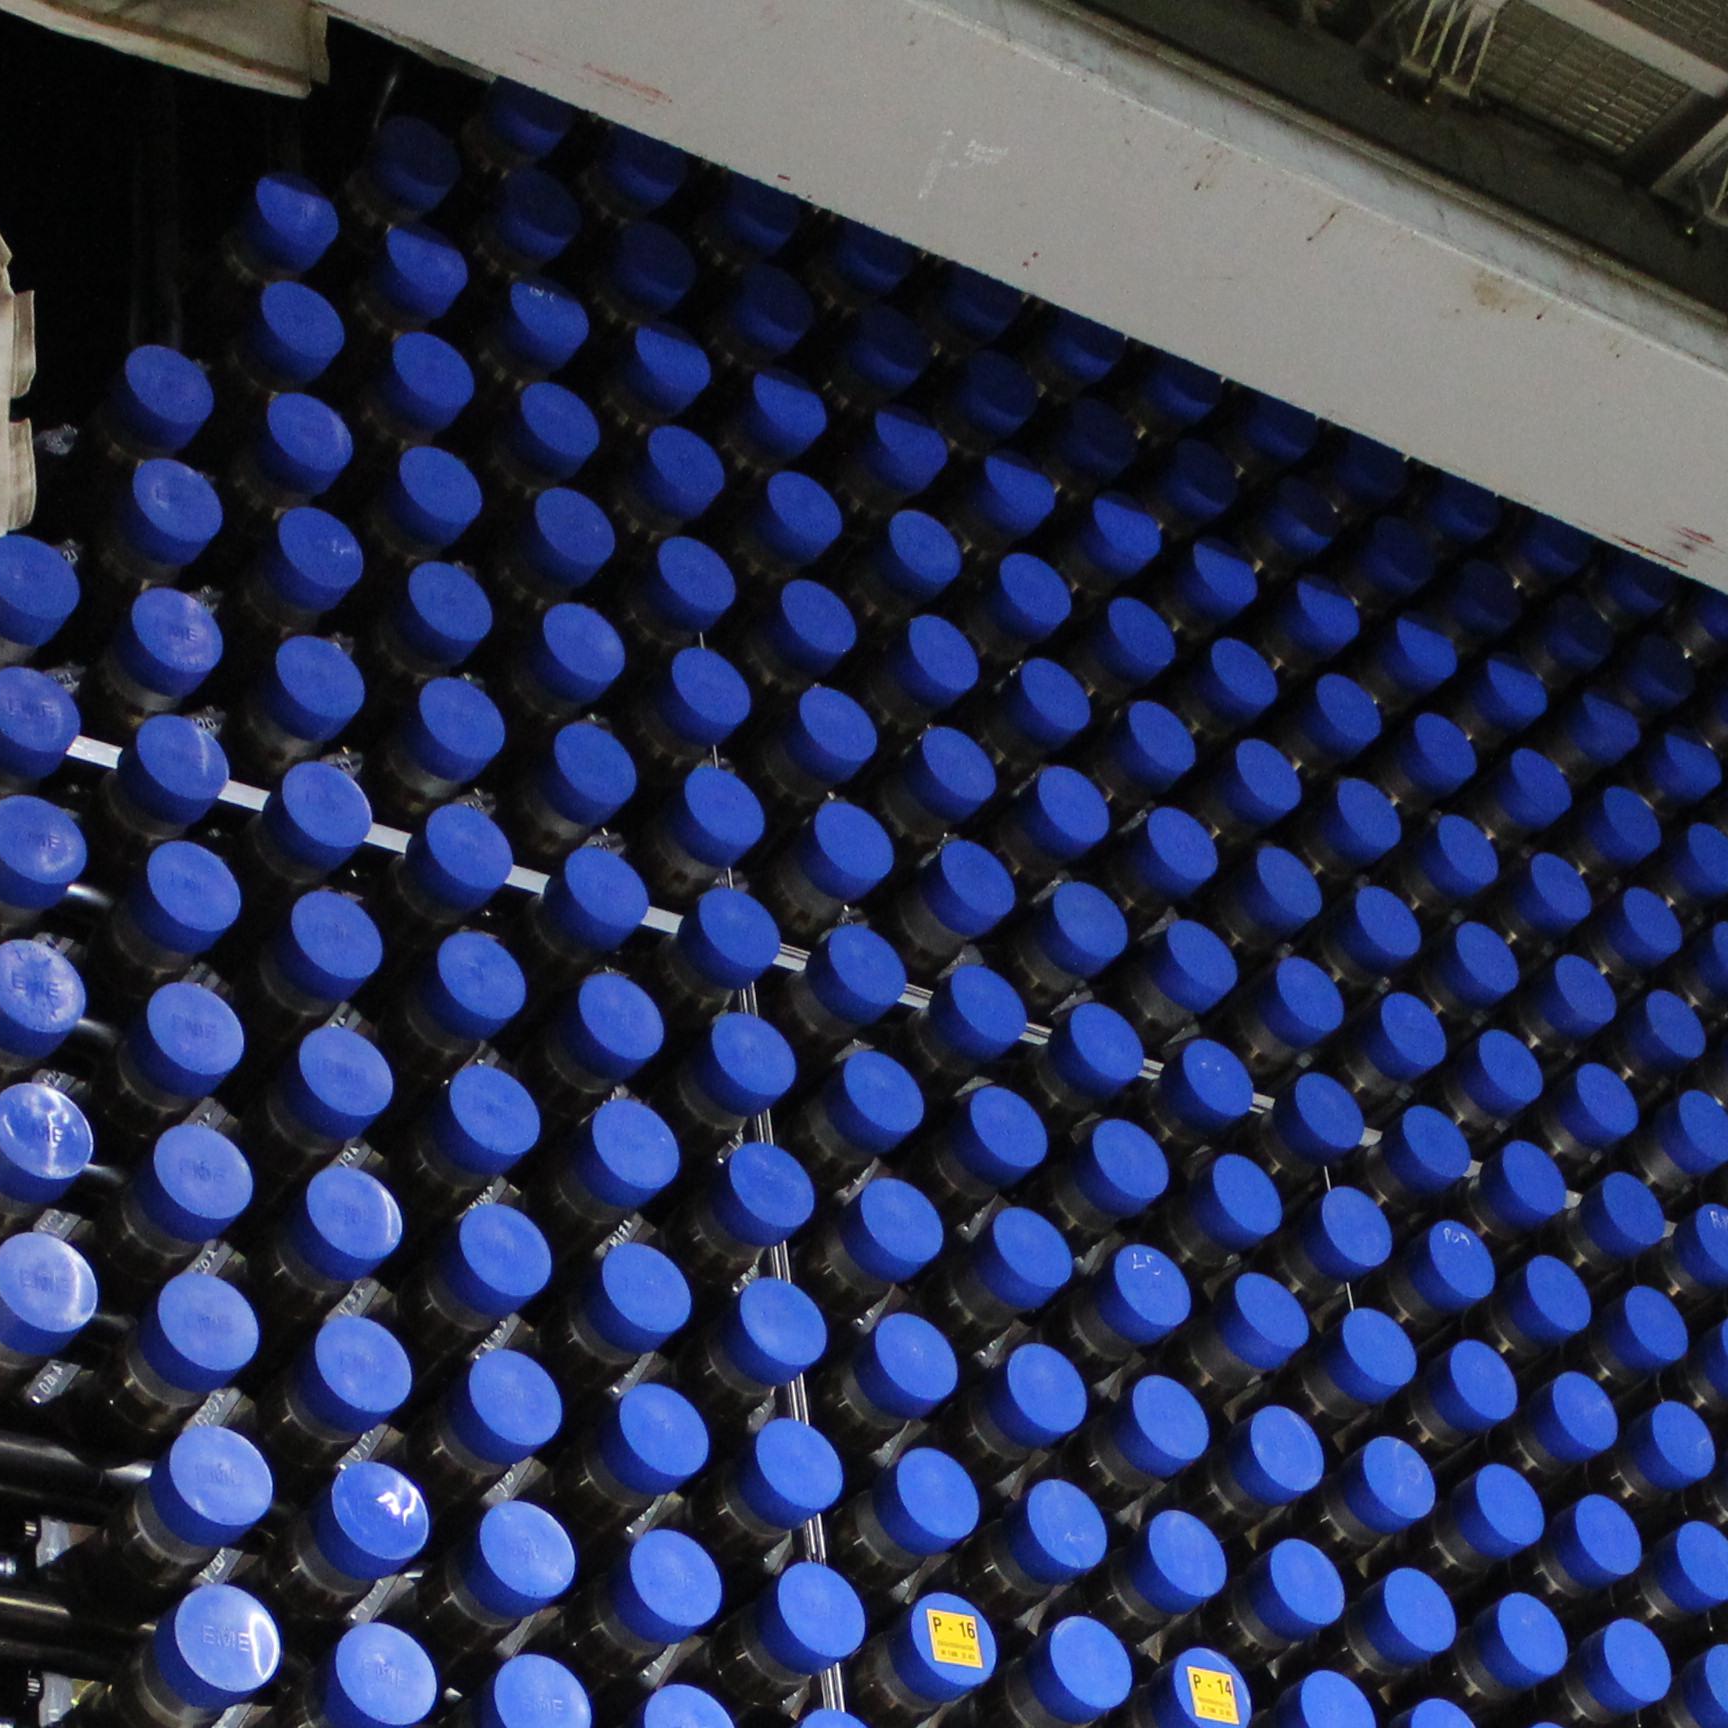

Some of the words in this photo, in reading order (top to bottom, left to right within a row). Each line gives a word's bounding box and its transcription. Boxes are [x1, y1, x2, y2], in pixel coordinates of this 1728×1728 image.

[202, 1625, 251, 1653] EME
[932, 1616, 942, 1633] P
[958, 1620, 976, 1640] 16
[1193, 1673, 1202, 1690] P
[1217, 1678, 1233, 1697] 14
